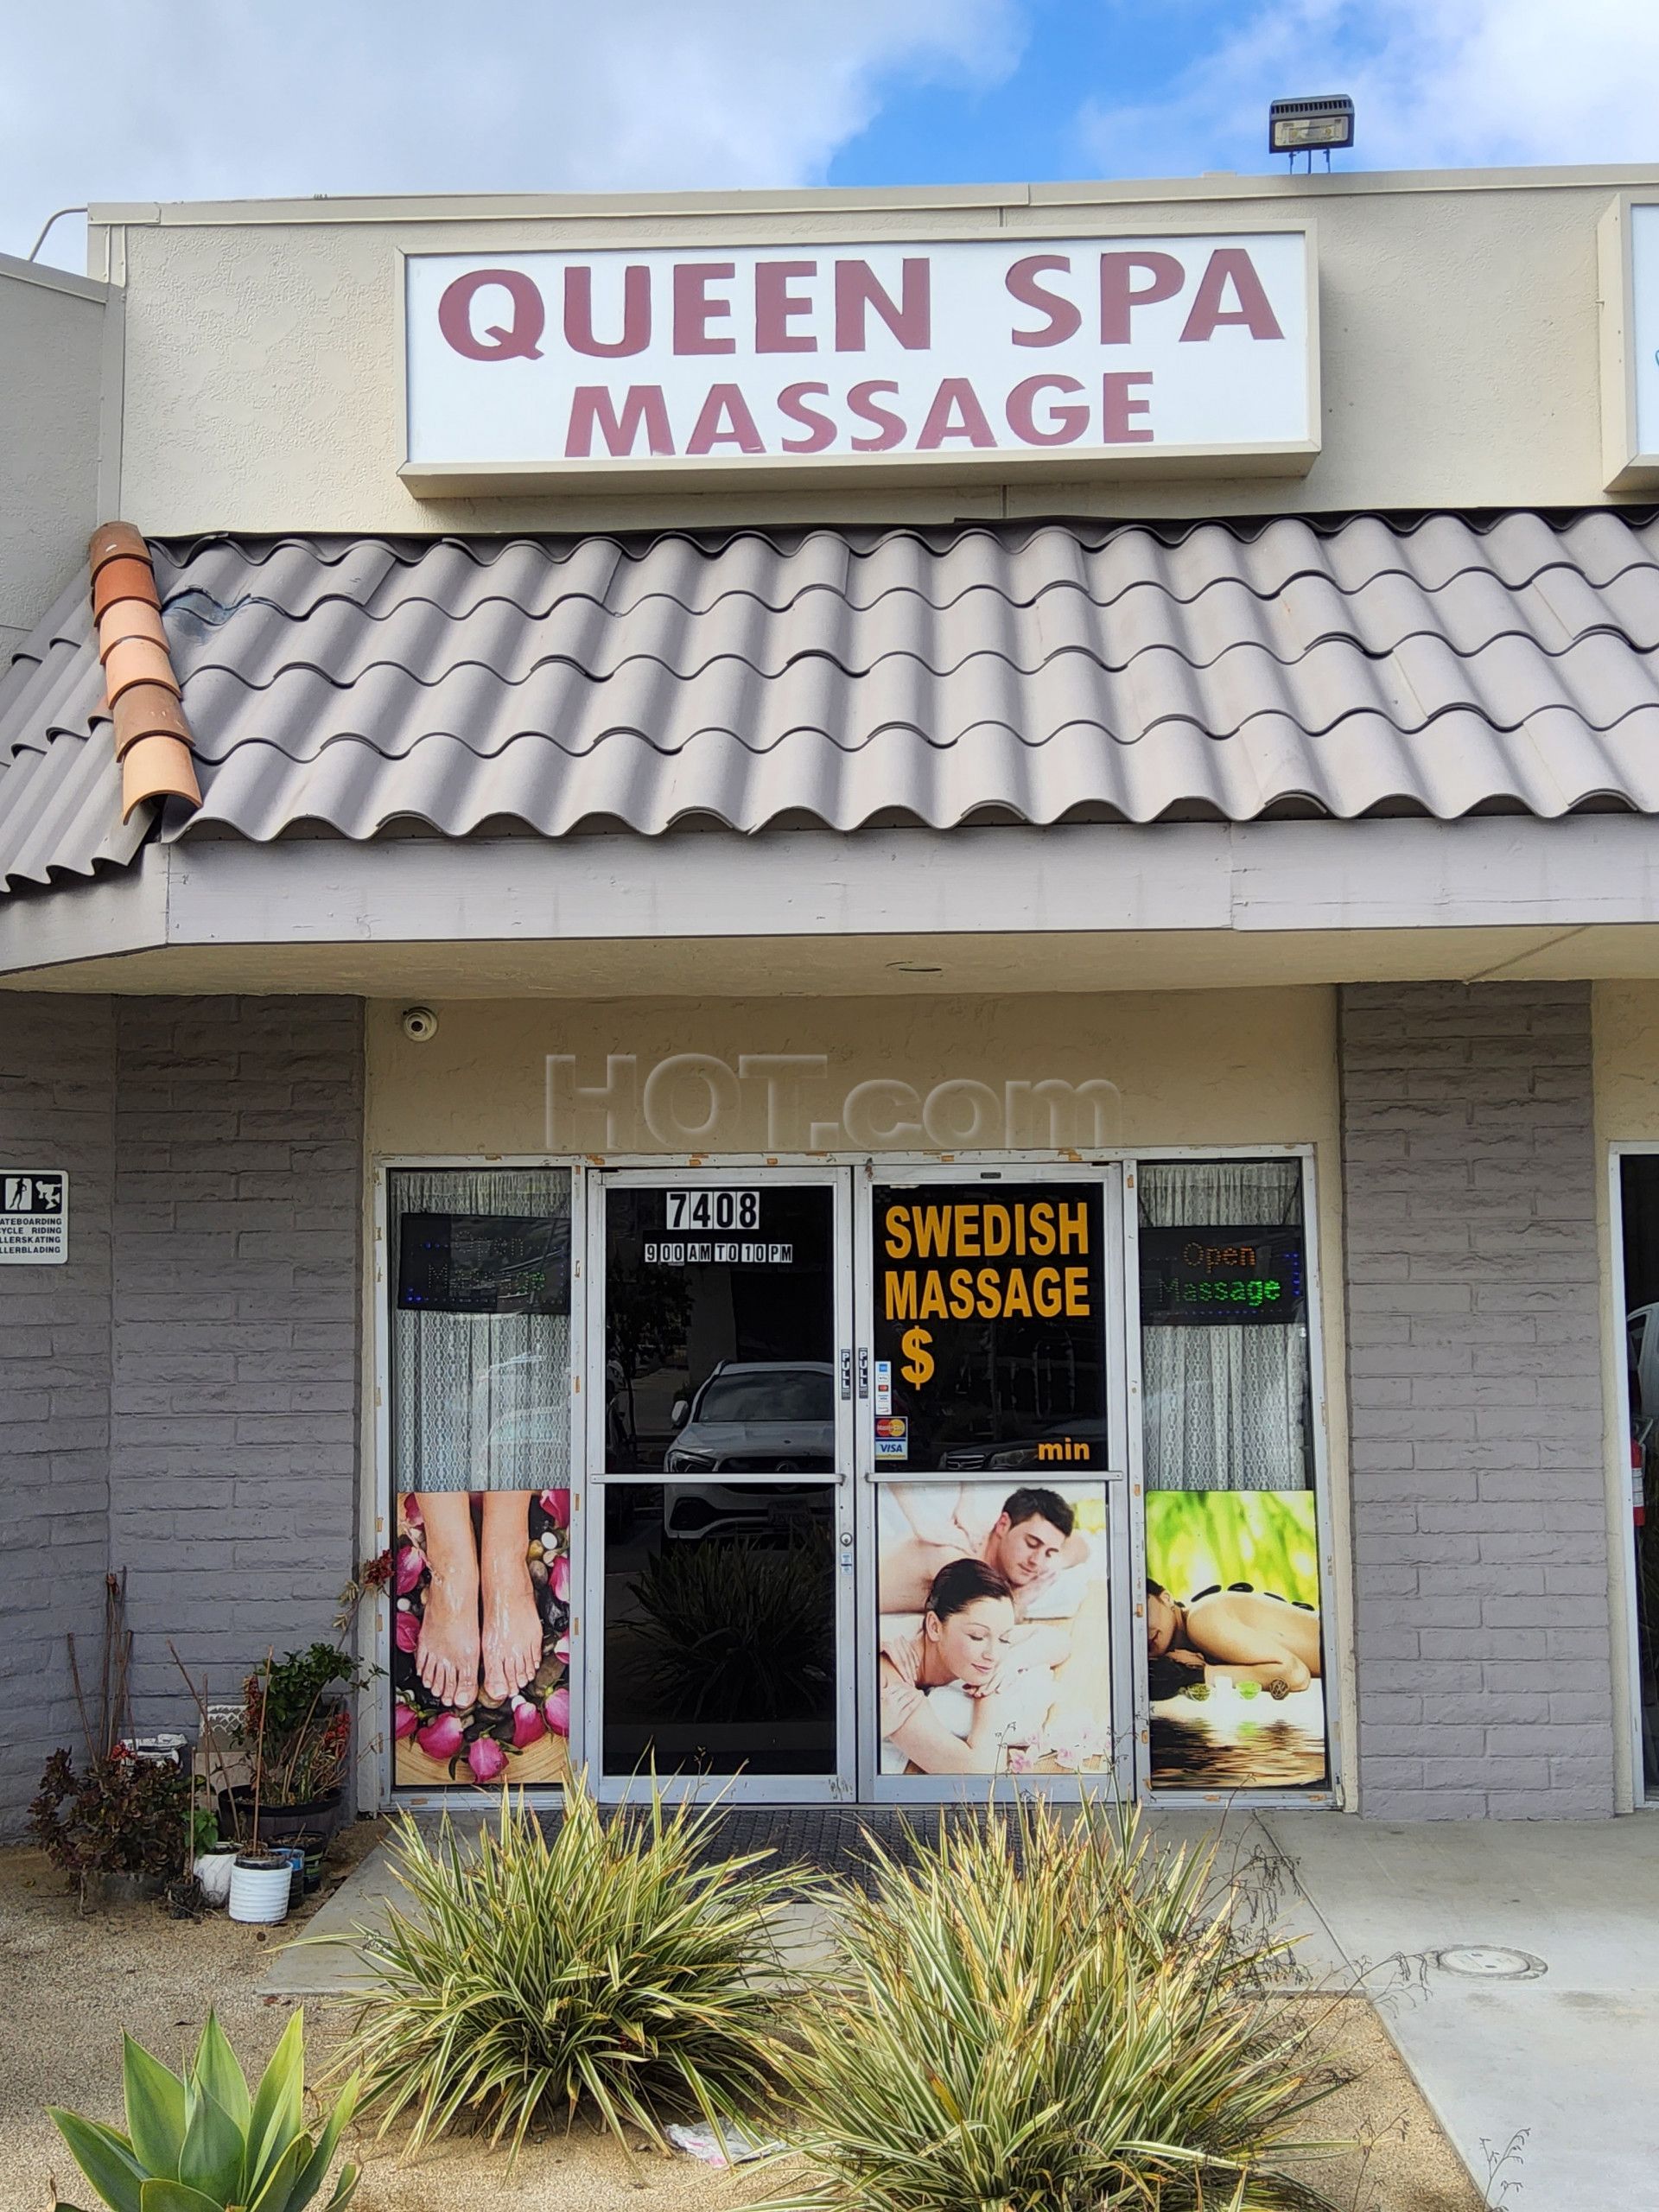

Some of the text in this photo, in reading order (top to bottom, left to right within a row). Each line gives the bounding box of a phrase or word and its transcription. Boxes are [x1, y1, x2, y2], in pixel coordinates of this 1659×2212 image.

[438, 247, 1286, 361] QUEEN SPA
[563, 372, 1155, 458] MASSAGE
[670, 1192, 757, 1229] 7408
[884, 1202, 1090, 1259] SWEDISH
[1184, 1242, 1256, 1273] Open
[885, 1268, 1090, 1320] MASSAGE
[1158, 1277, 1281, 1306] Massage
[842, 1352, 850, 1388] PULL
[900, 1325, 935, 1390] $
[880, 1444, 903, 1452] VISA
[1039, 1438, 1090, 1461] min
